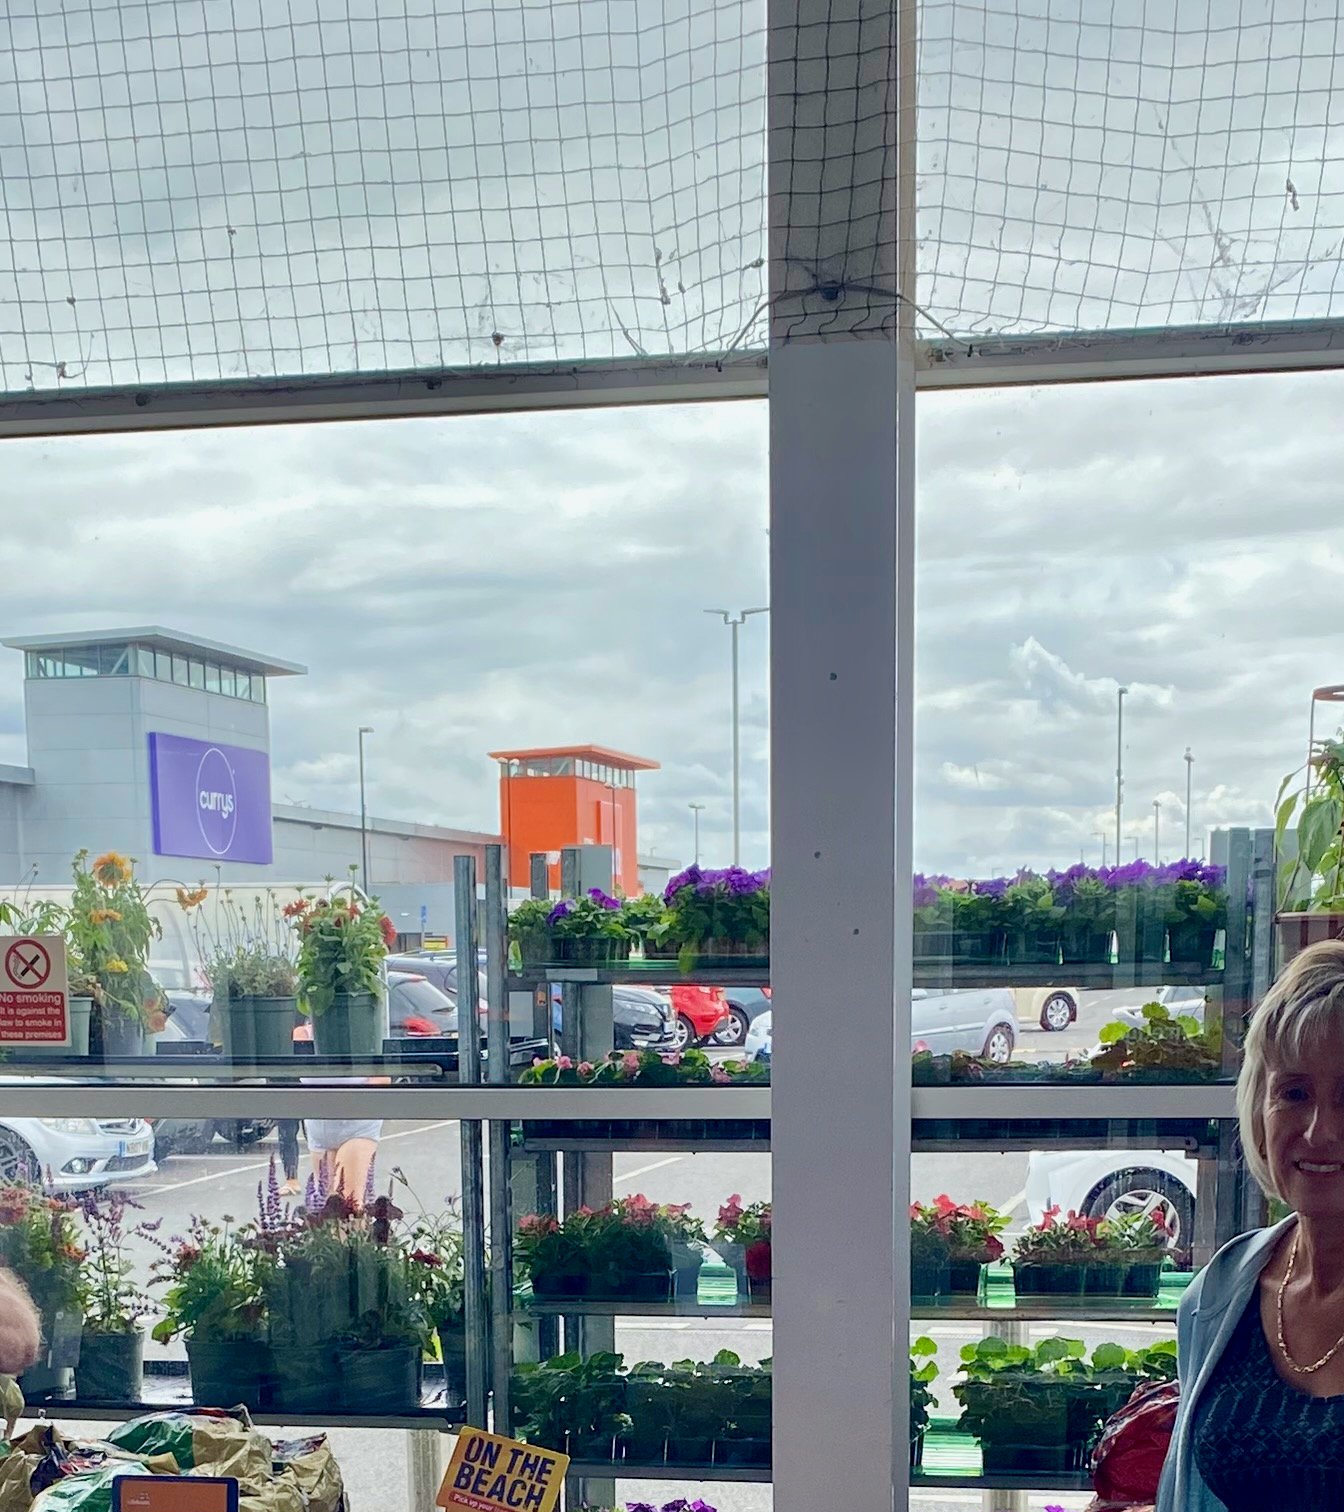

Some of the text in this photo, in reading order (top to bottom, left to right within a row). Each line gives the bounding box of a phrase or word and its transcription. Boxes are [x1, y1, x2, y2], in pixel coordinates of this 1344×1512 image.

[199, 790, 234, 819] currys
[16, 993, 61, 1005] smoking
[0, 1007, 61, 1017] It is against the
[0, 1018, 62, 1027] law to smoke in
[1, 1030, 63, 1040] these premises
[463, 1436, 556, 1486] ON THE
[453, 1493, 469, 1507] Pick
[468, 1499, 479, 1511] up
